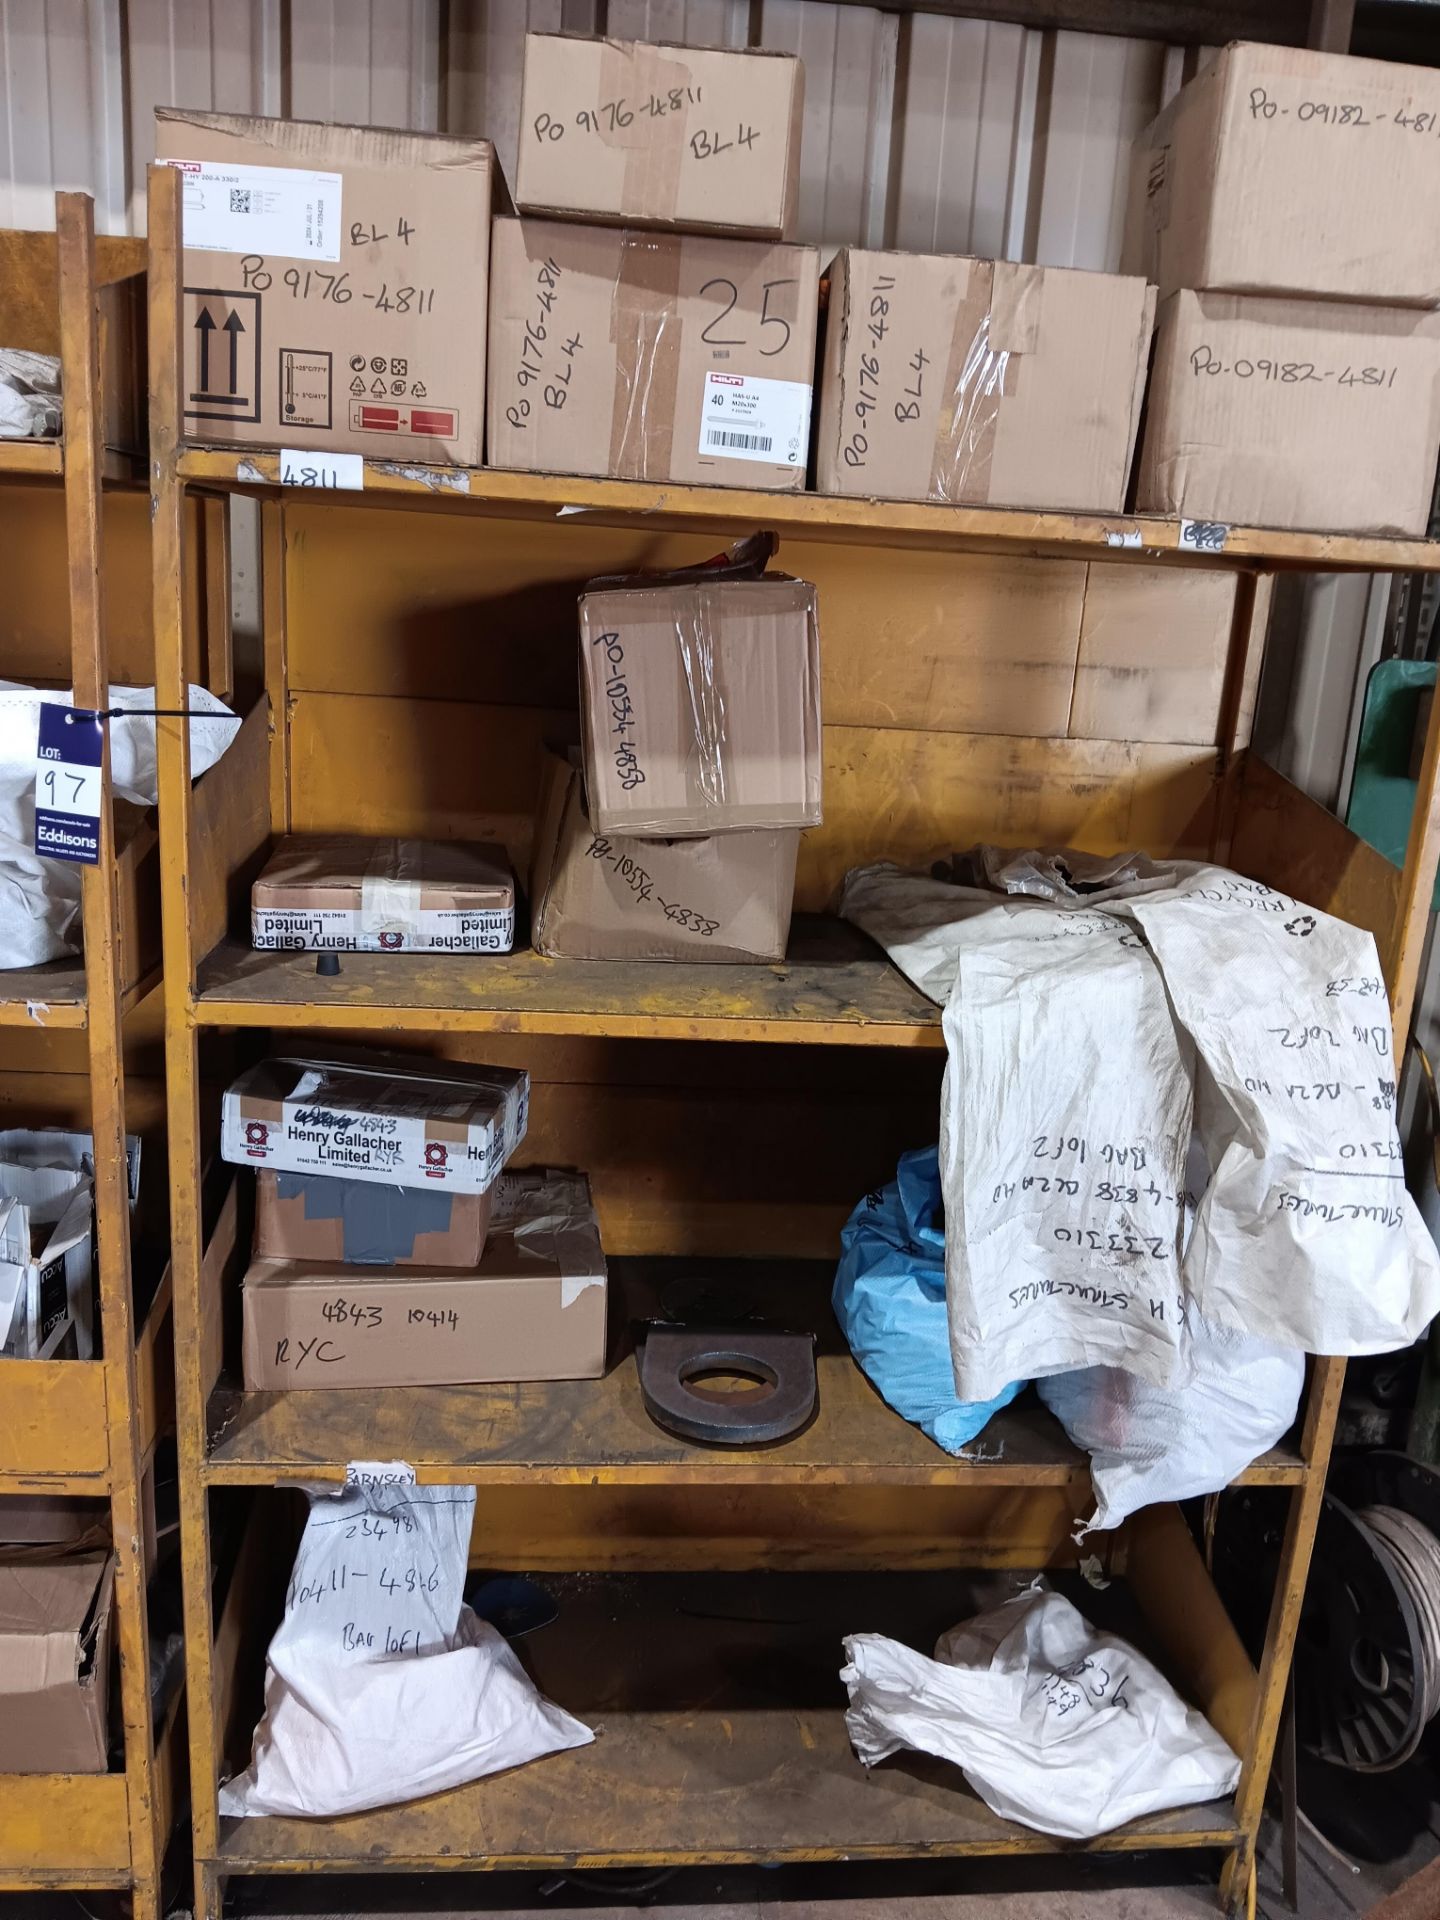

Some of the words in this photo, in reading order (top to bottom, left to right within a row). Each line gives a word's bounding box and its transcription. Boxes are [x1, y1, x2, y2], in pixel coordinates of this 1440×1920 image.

[576, 87, 702, 133] 9176-4811
[1250, 87, 1440, 137] Po-09182-481
[284, 268, 434, 314] 9176-4811
[517, 258, 562, 387] 9176-4811
[700, 278, 798, 356] 25
[711, 375, 743, 386] HILTI
[711, 394, 724, 406] 40
[285, 414, 314, 424] Storage
[282, 464, 337, 487] 4811
[40, 746, 61, 760] LOT:
[45, 770, 86, 806] 97
[38, 825, 97, 849] Eddisons
[265, 919, 323, 934] Limited
[462, 917, 512, 934] Limited
[311, 933, 357, 949] Henry
[429, 935, 500, 950] Gallacher
[288, 1126, 329, 1146] Henry
[333, 1131, 402, 1152] Gallacher
[318, 1145, 370, 1163] Limited
[1054, 1228, 1169, 1259] 233310
[1009, 1279, 1129, 1309] STRUCTURES
[322, 1298, 383, 1328] 4843
[408, 1309, 459, 1331] 10414
[275, 1337, 346, 1369] RYC
[347, 1468, 415, 1488] BARNSLEY
